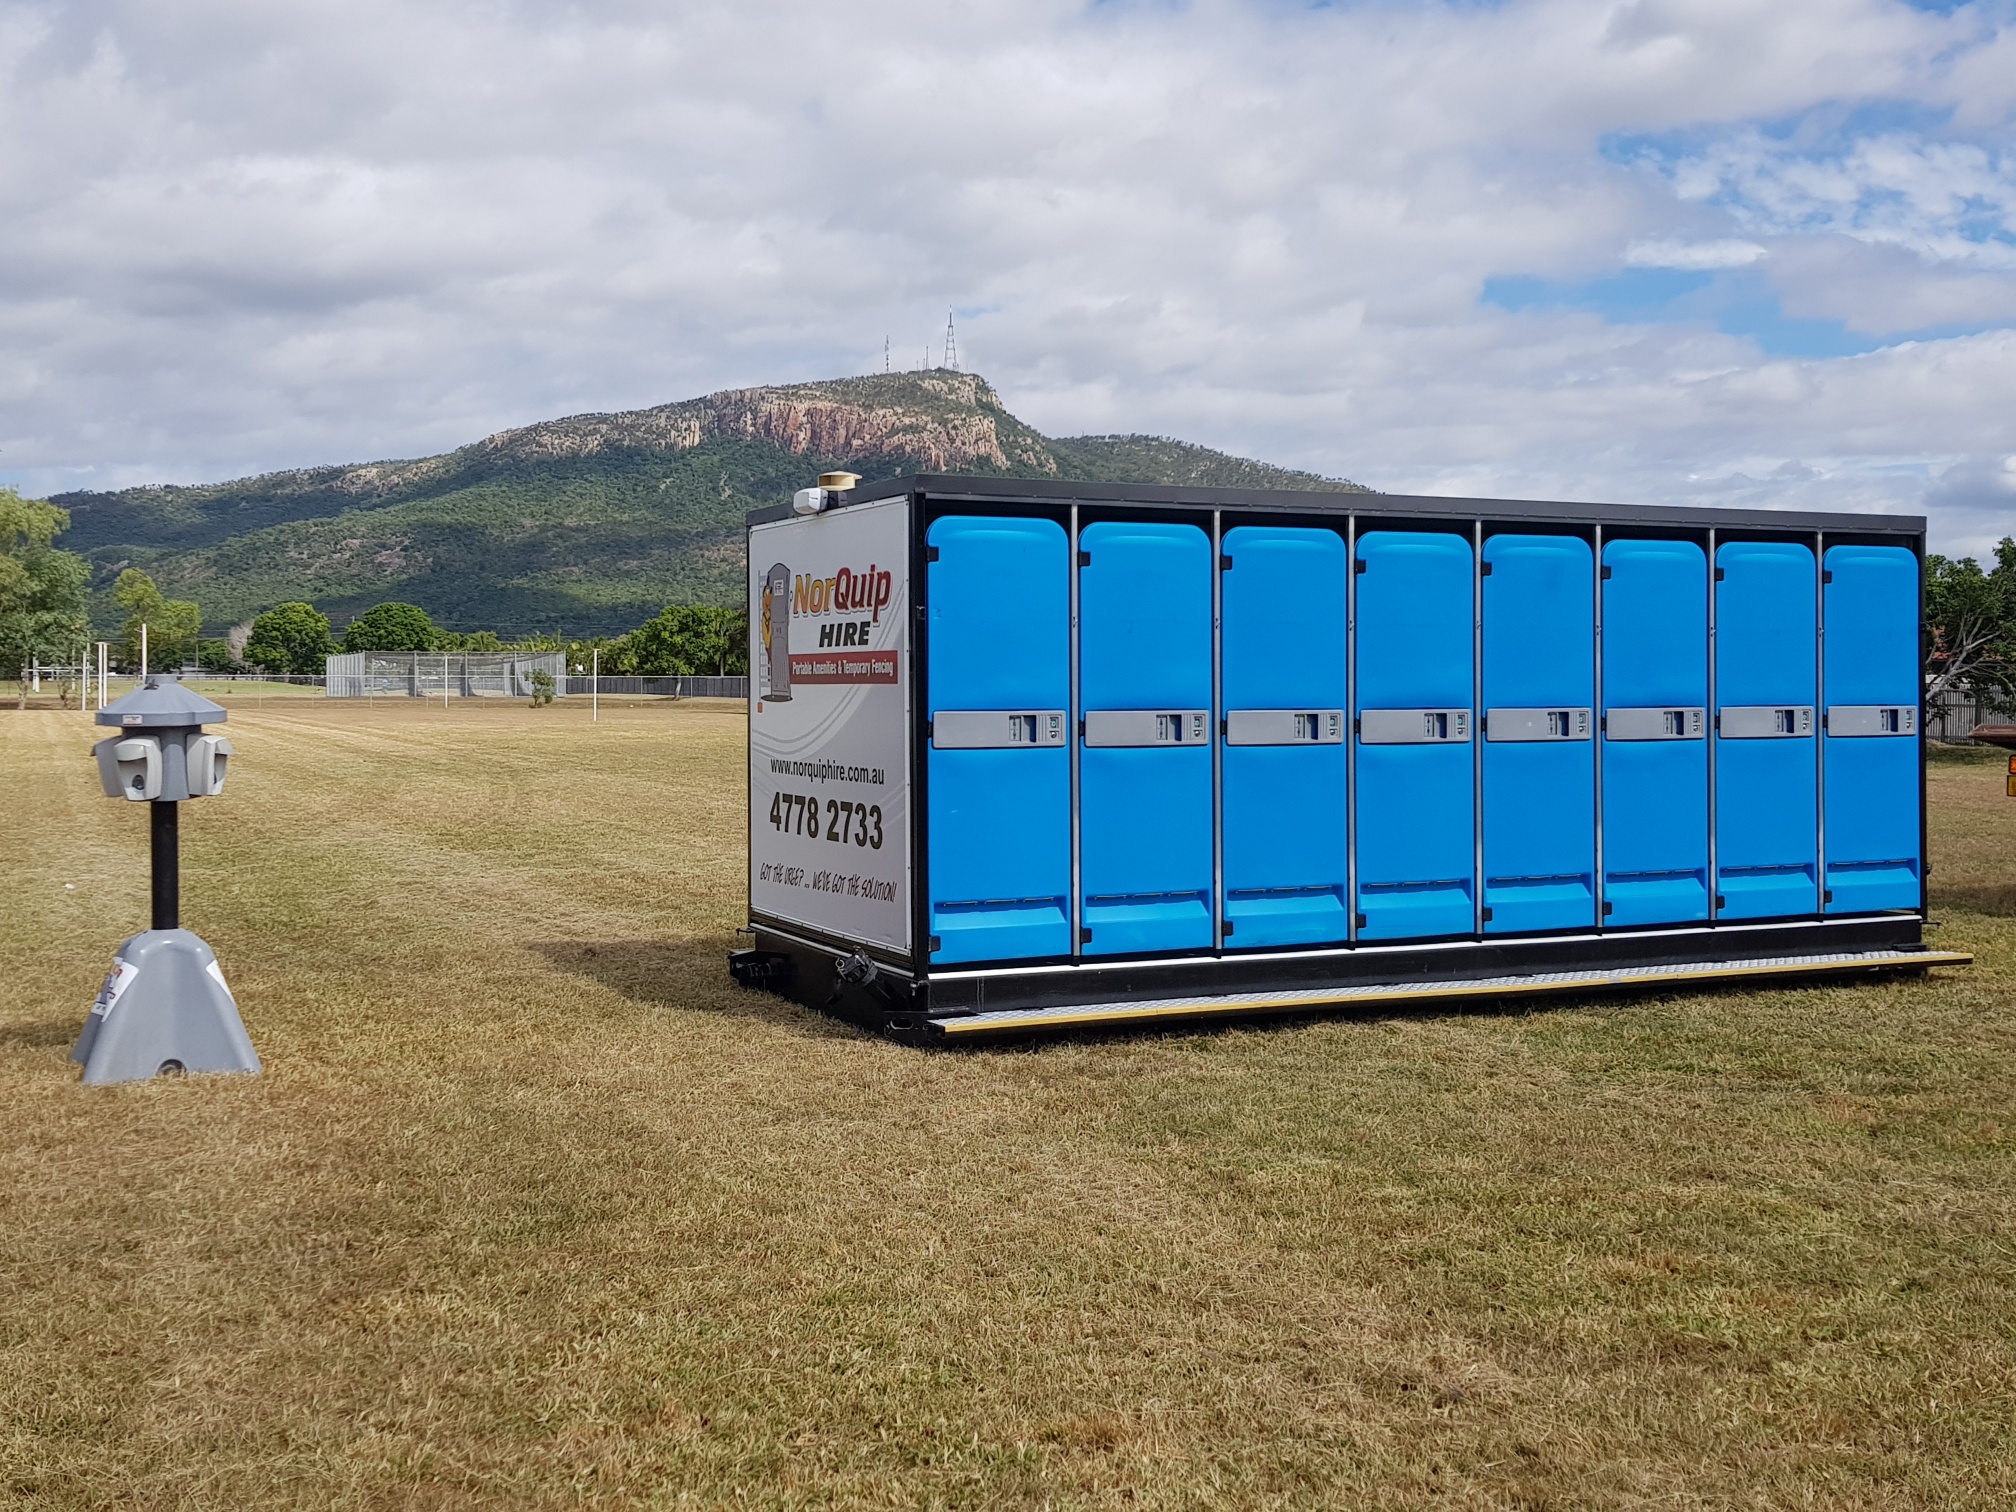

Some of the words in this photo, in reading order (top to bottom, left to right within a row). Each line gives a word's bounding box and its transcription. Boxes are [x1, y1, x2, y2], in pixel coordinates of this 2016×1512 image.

[793, 564, 892, 624] NorQuip
[818, 621, 871, 648] HIRE
[792, 661, 812, 675] Portable
[813, 660, 837, 675] Amenities
[837, 660, 843, 674] &
[843, 659, 871, 677] Temporary
[871, 658, 893, 677] Fencing
[770, 758, 885, 785] www.norquiphire.com.au
[769, 791, 820, 839] 4778
[826, 799, 883, 850] 2733
[760, 862, 772, 881] GOT
[772, 863, 784, 884] THE
[784, 866, 804, 887] URGE?
[831, 873, 846, 895] GOT
[847, 873, 860, 897] THE
[861, 877, 897, 903] SOLUTION!
